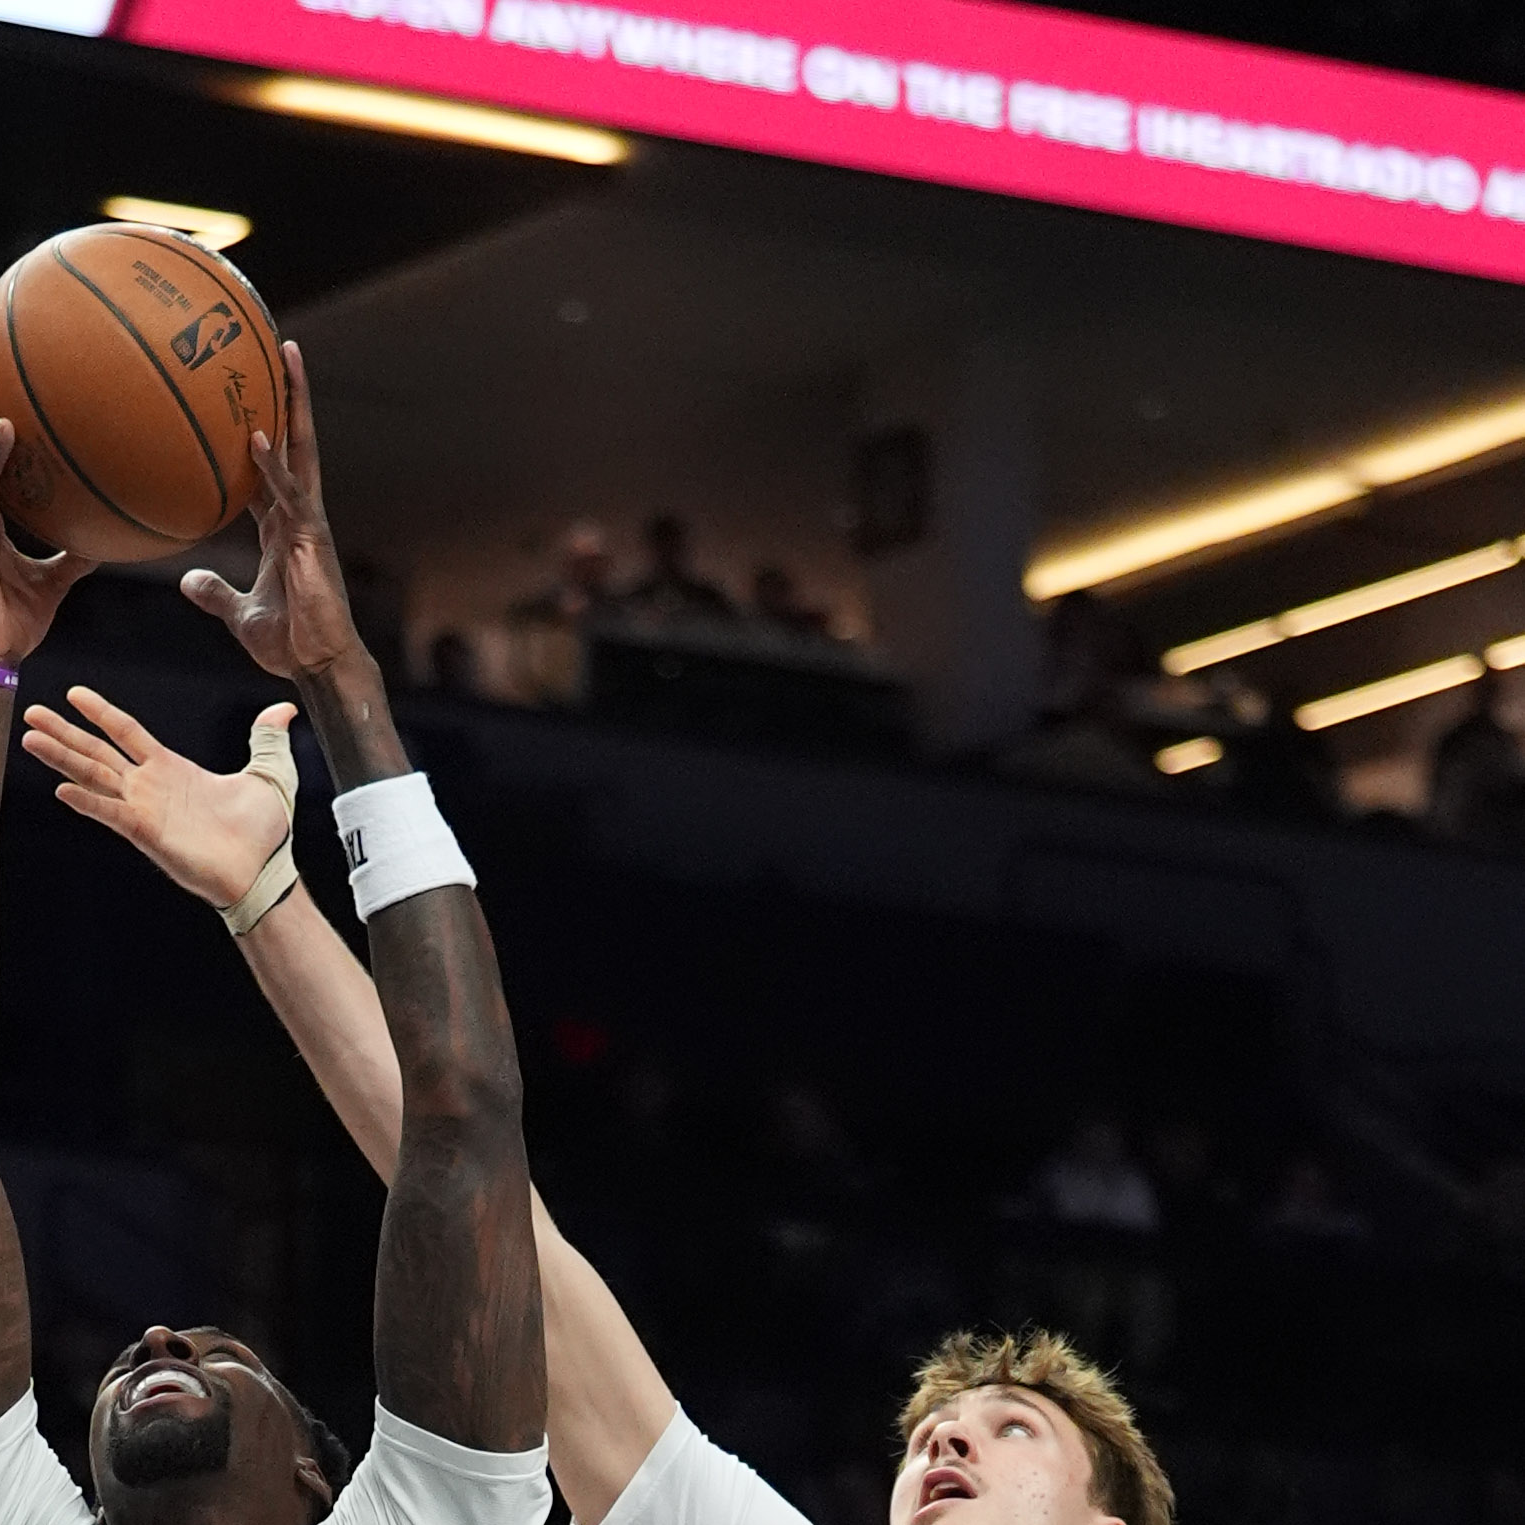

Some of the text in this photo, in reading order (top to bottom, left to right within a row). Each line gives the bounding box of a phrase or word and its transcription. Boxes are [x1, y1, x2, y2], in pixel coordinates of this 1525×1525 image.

[488, 0, 800, 94] ANYWHERE
[801, 44, 901, 112] ON
[903, 61, 1004, 130] THE
[1007, 80, 1133, 154] FREE
